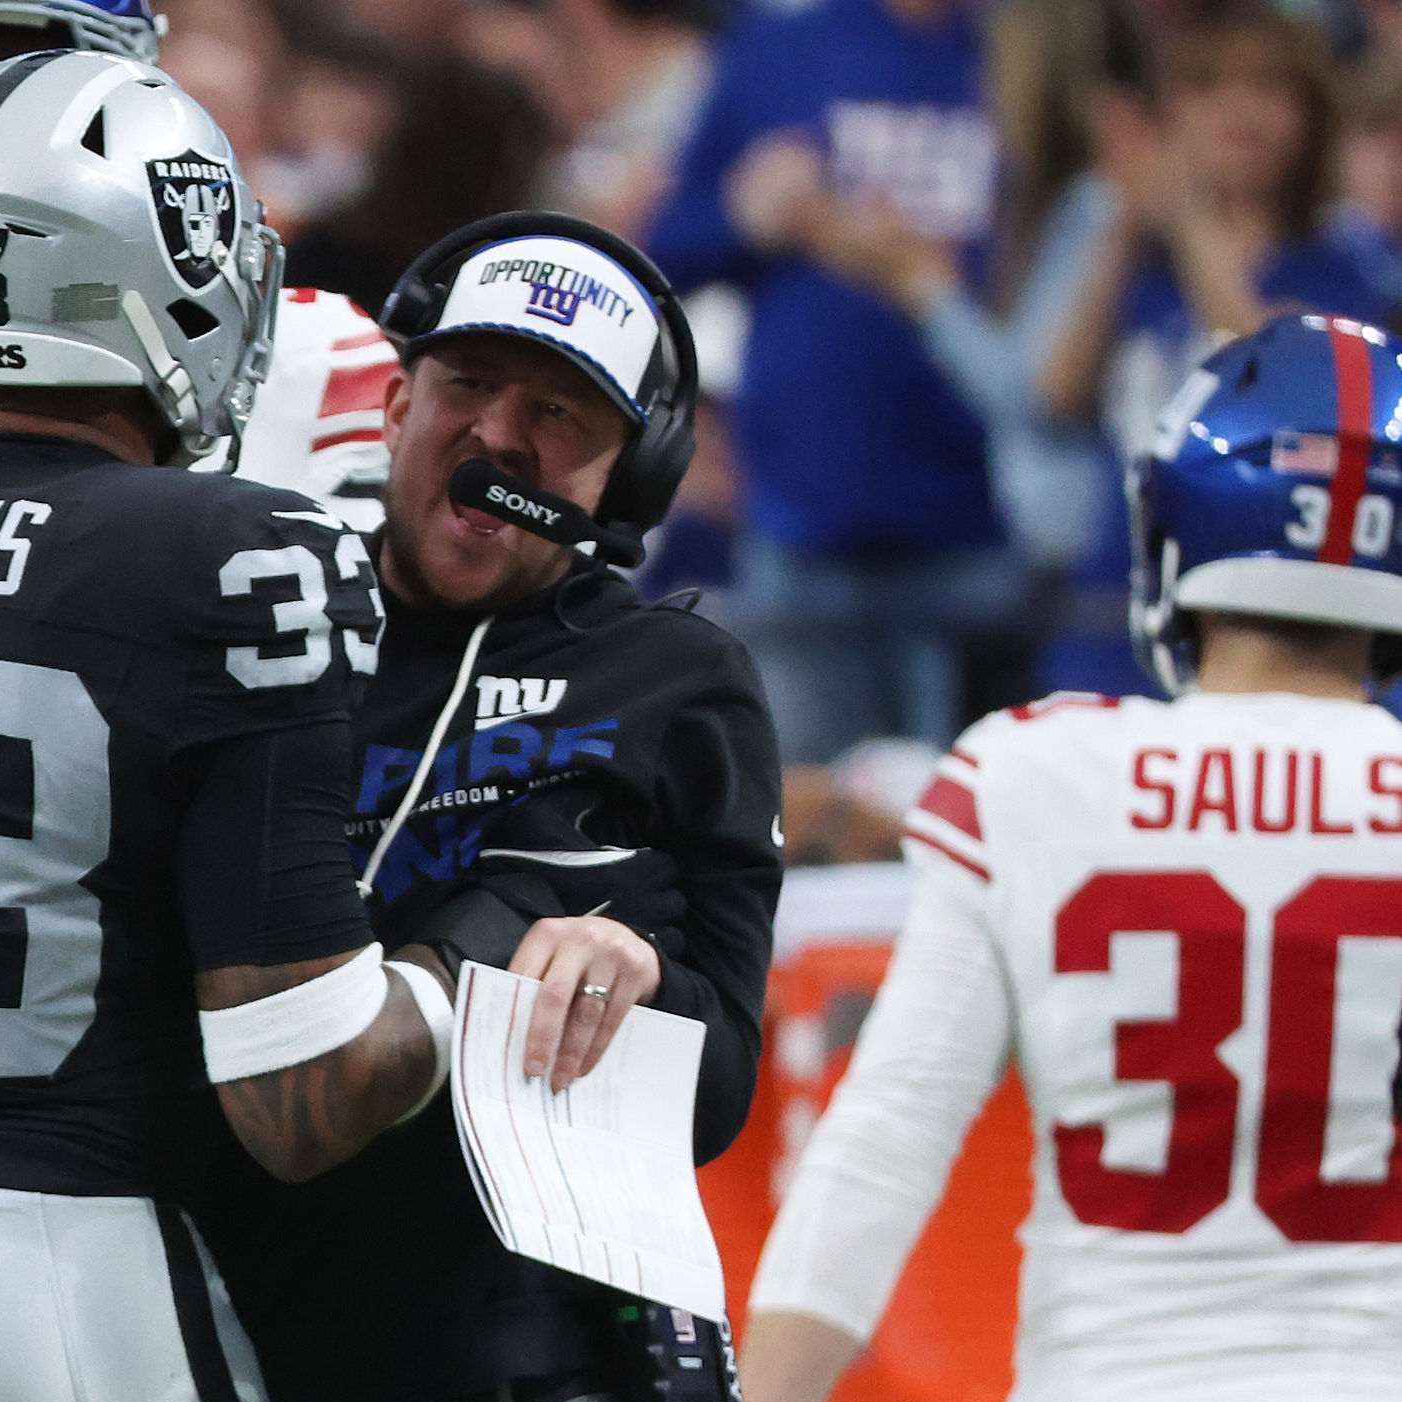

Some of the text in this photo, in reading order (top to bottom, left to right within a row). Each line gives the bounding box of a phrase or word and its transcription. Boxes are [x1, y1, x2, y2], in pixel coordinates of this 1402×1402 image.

[479, 259, 634, 329] OPPORTUNITY
[485, 485, 562, 526] SONY
[1284, 485, 1394, 559] 30
[218, 533, 385, 690] 33
[1053, 868, 1402, 1243] 30
